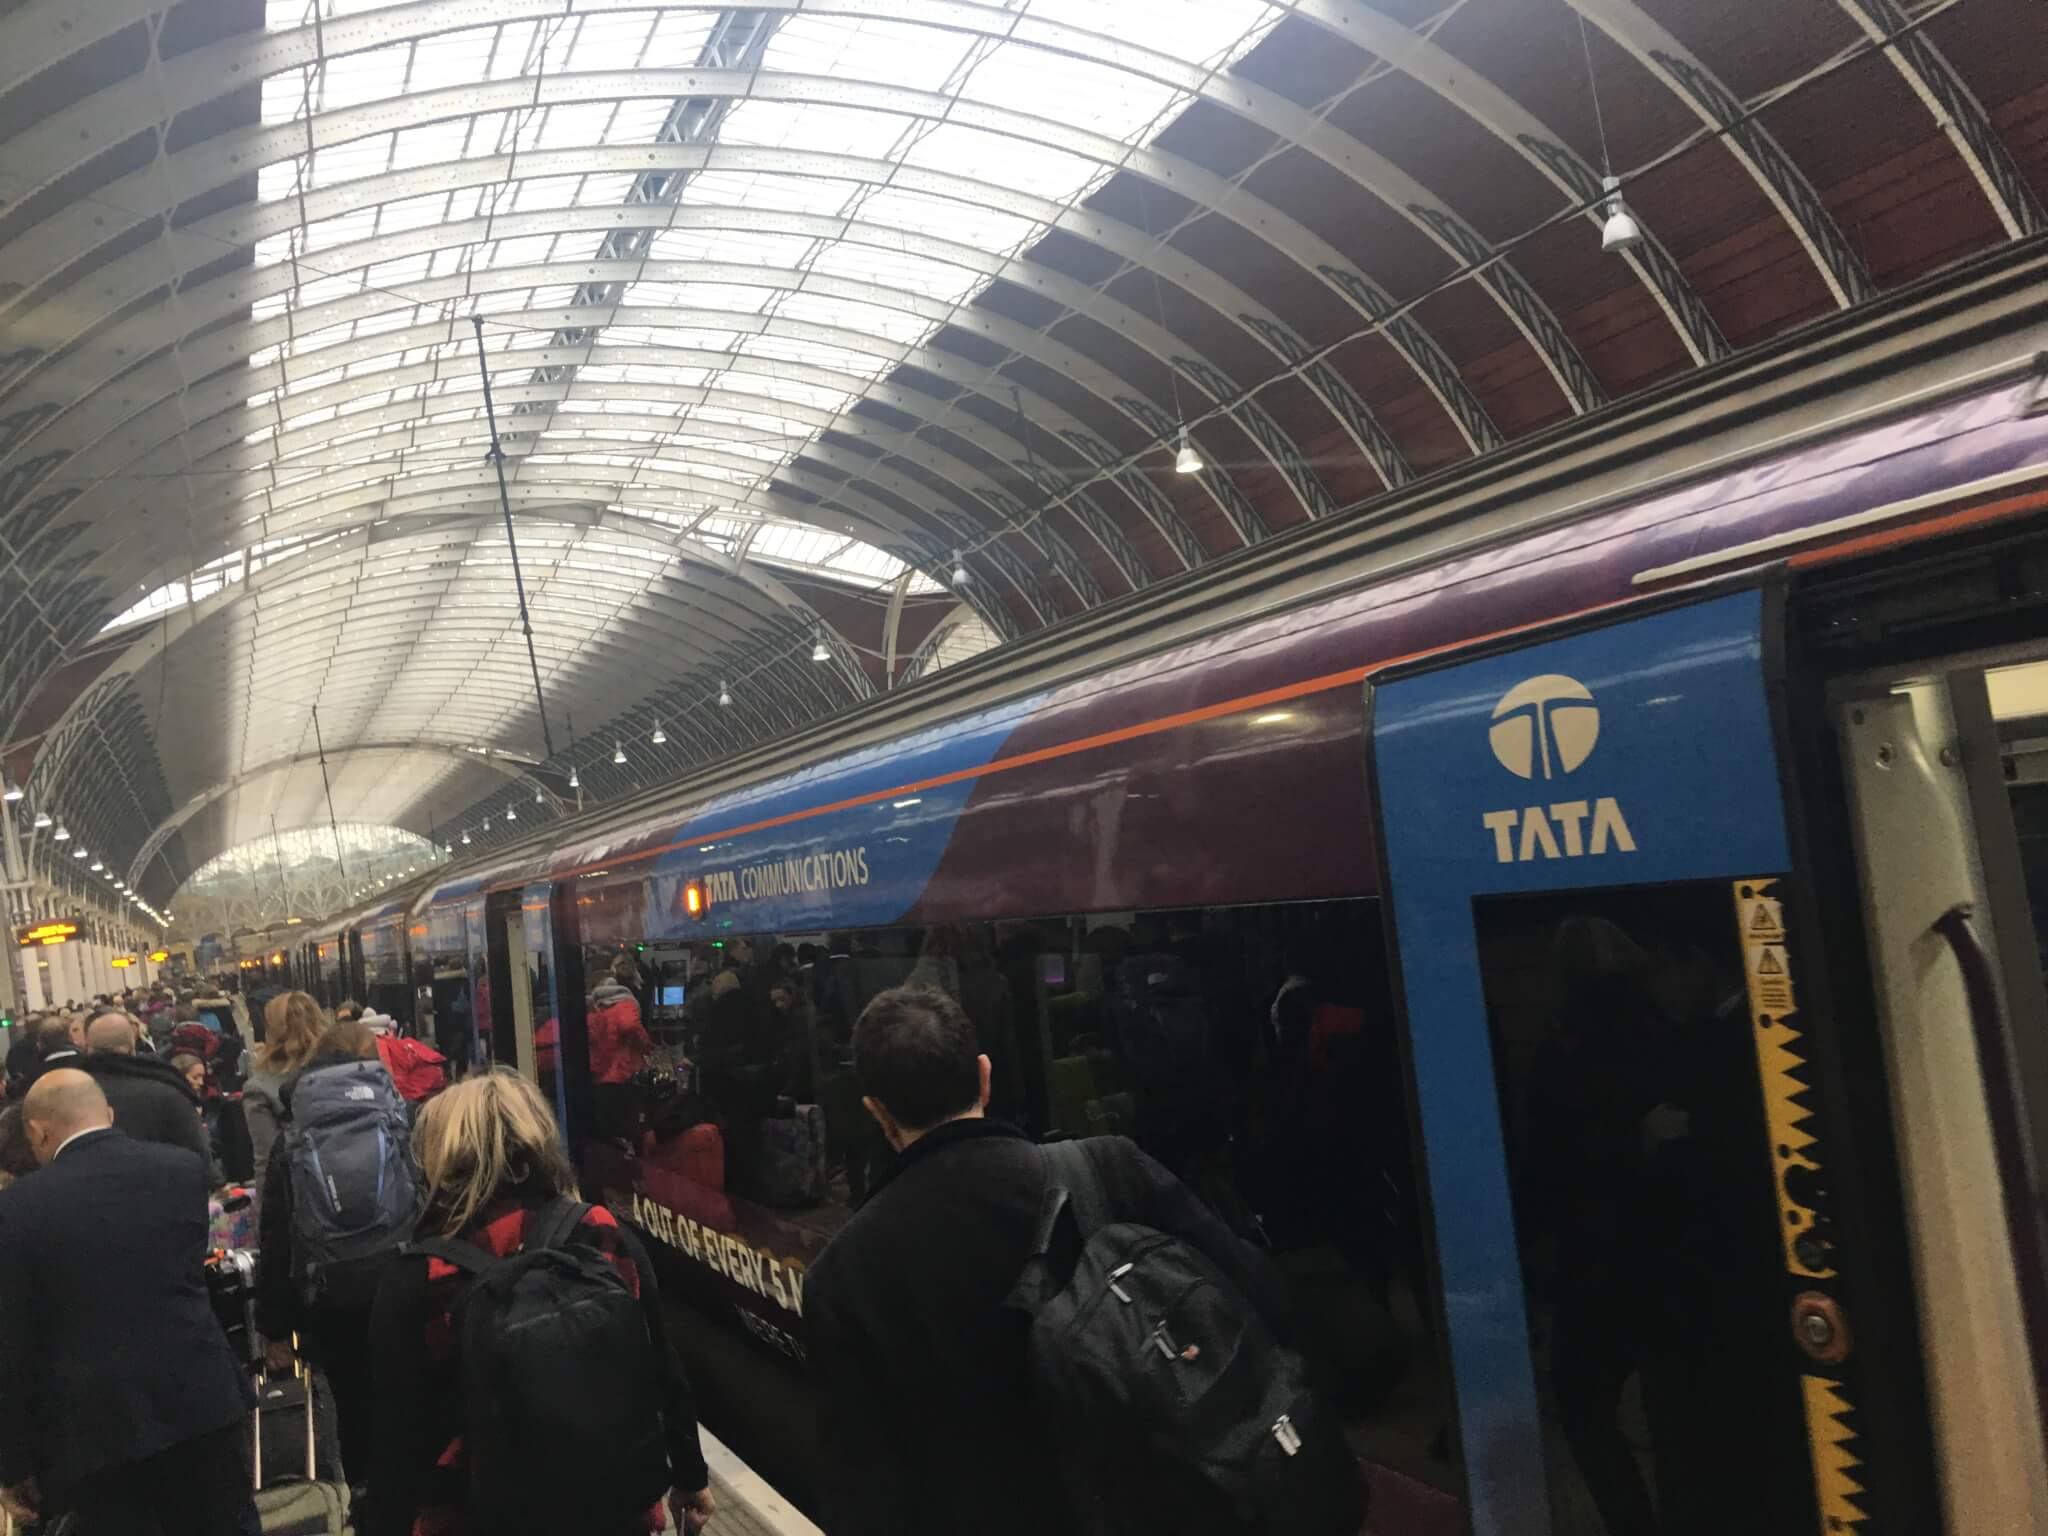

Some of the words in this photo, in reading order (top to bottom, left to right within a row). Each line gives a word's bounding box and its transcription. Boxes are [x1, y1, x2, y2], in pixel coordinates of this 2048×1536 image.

[1483, 797, 1638, 863] TATA
[704, 871, 738, 903] TATA
[741, 847, 868, 900] COMMUNICATIONS
[633, 1193, 644, 1231] 4
[643, 1198, 677, 1247] OUT
[676, 1214, 702, 1262] OF
[701, 1226, 767, 1298] EVERY
[769, 1259, 788, 1309] 5
